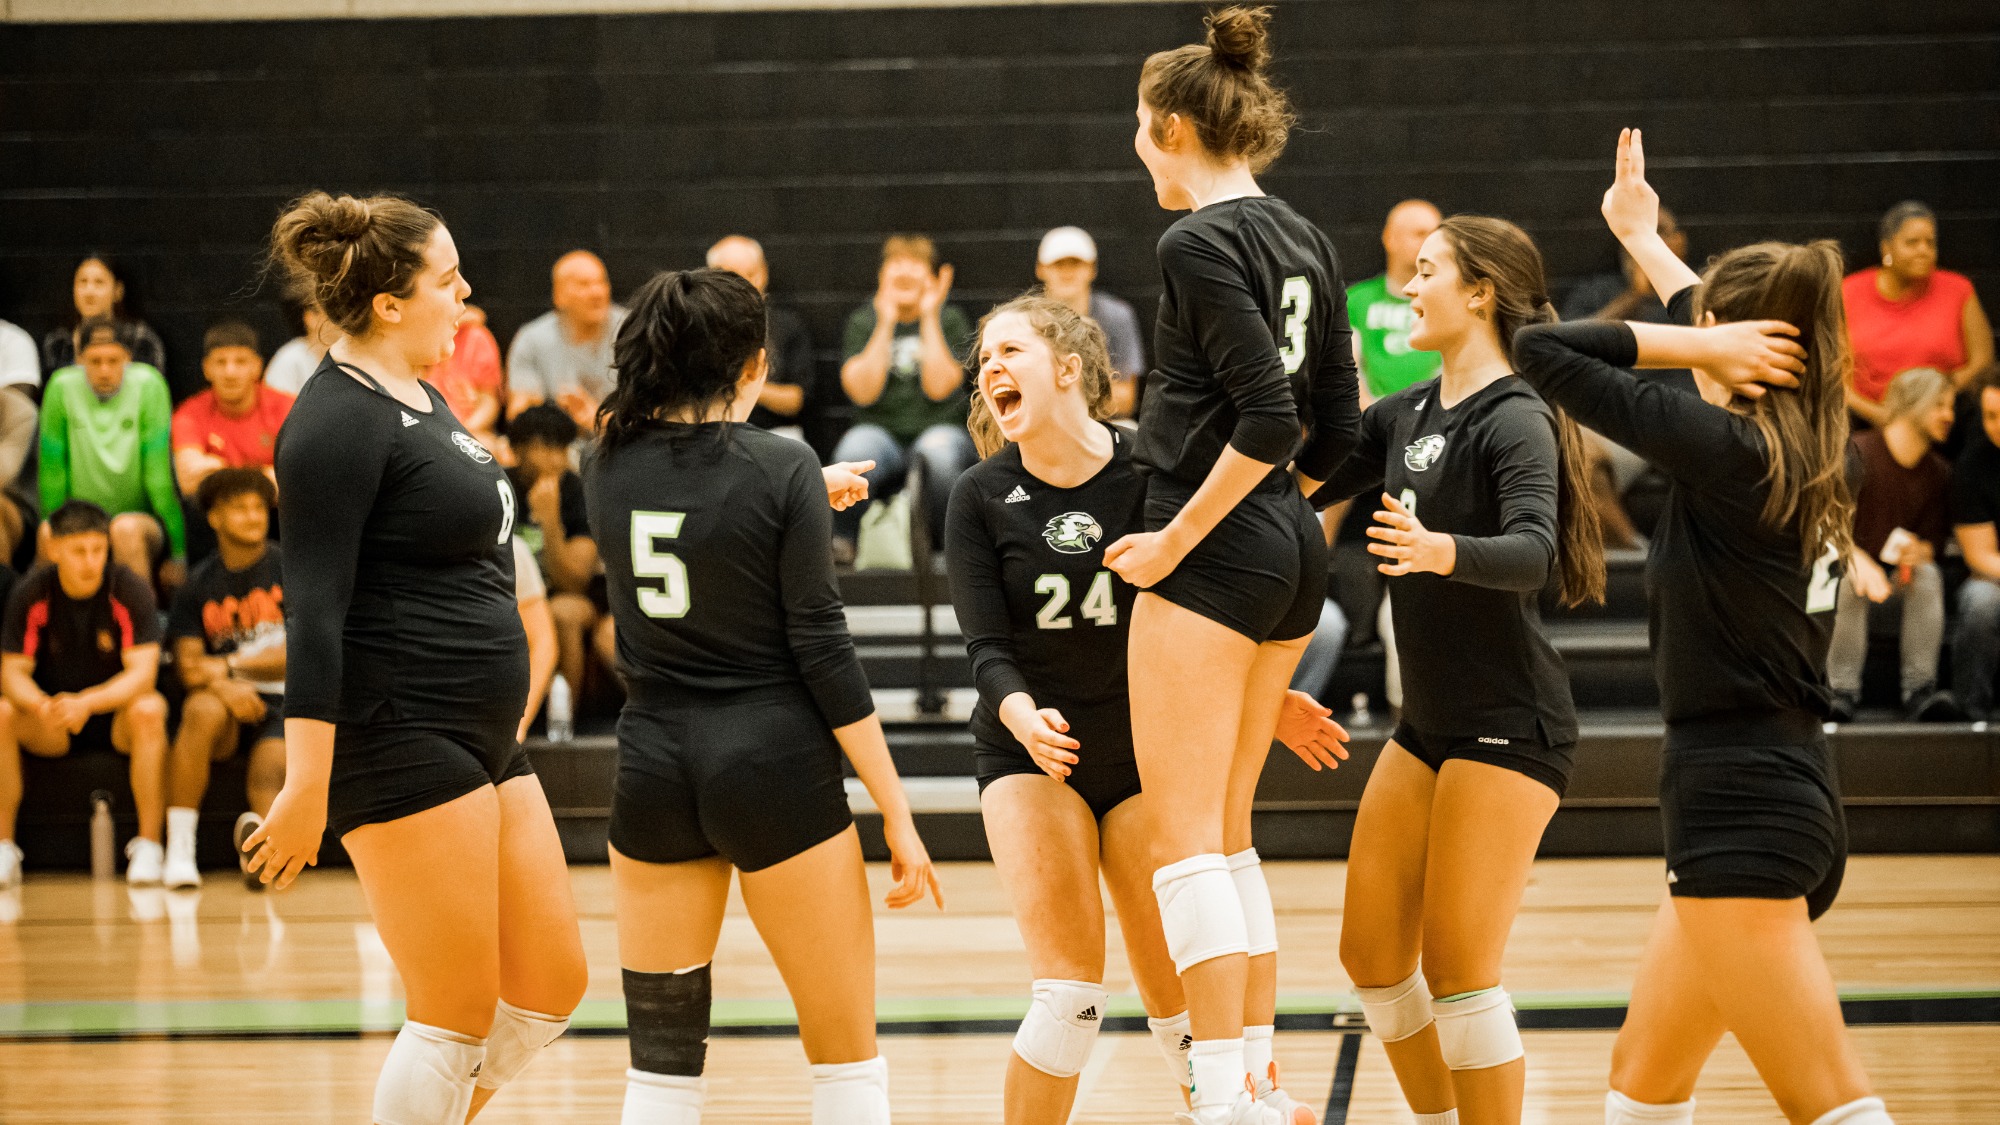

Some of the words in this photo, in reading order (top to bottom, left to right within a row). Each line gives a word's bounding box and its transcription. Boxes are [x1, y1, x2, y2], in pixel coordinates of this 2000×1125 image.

[1279, 275, 1312, 375] 3
[630, 510, 691, 619] 5
[1034, 571, 1118, 630] 24
[1477, 736, 1509, 745] adidas
